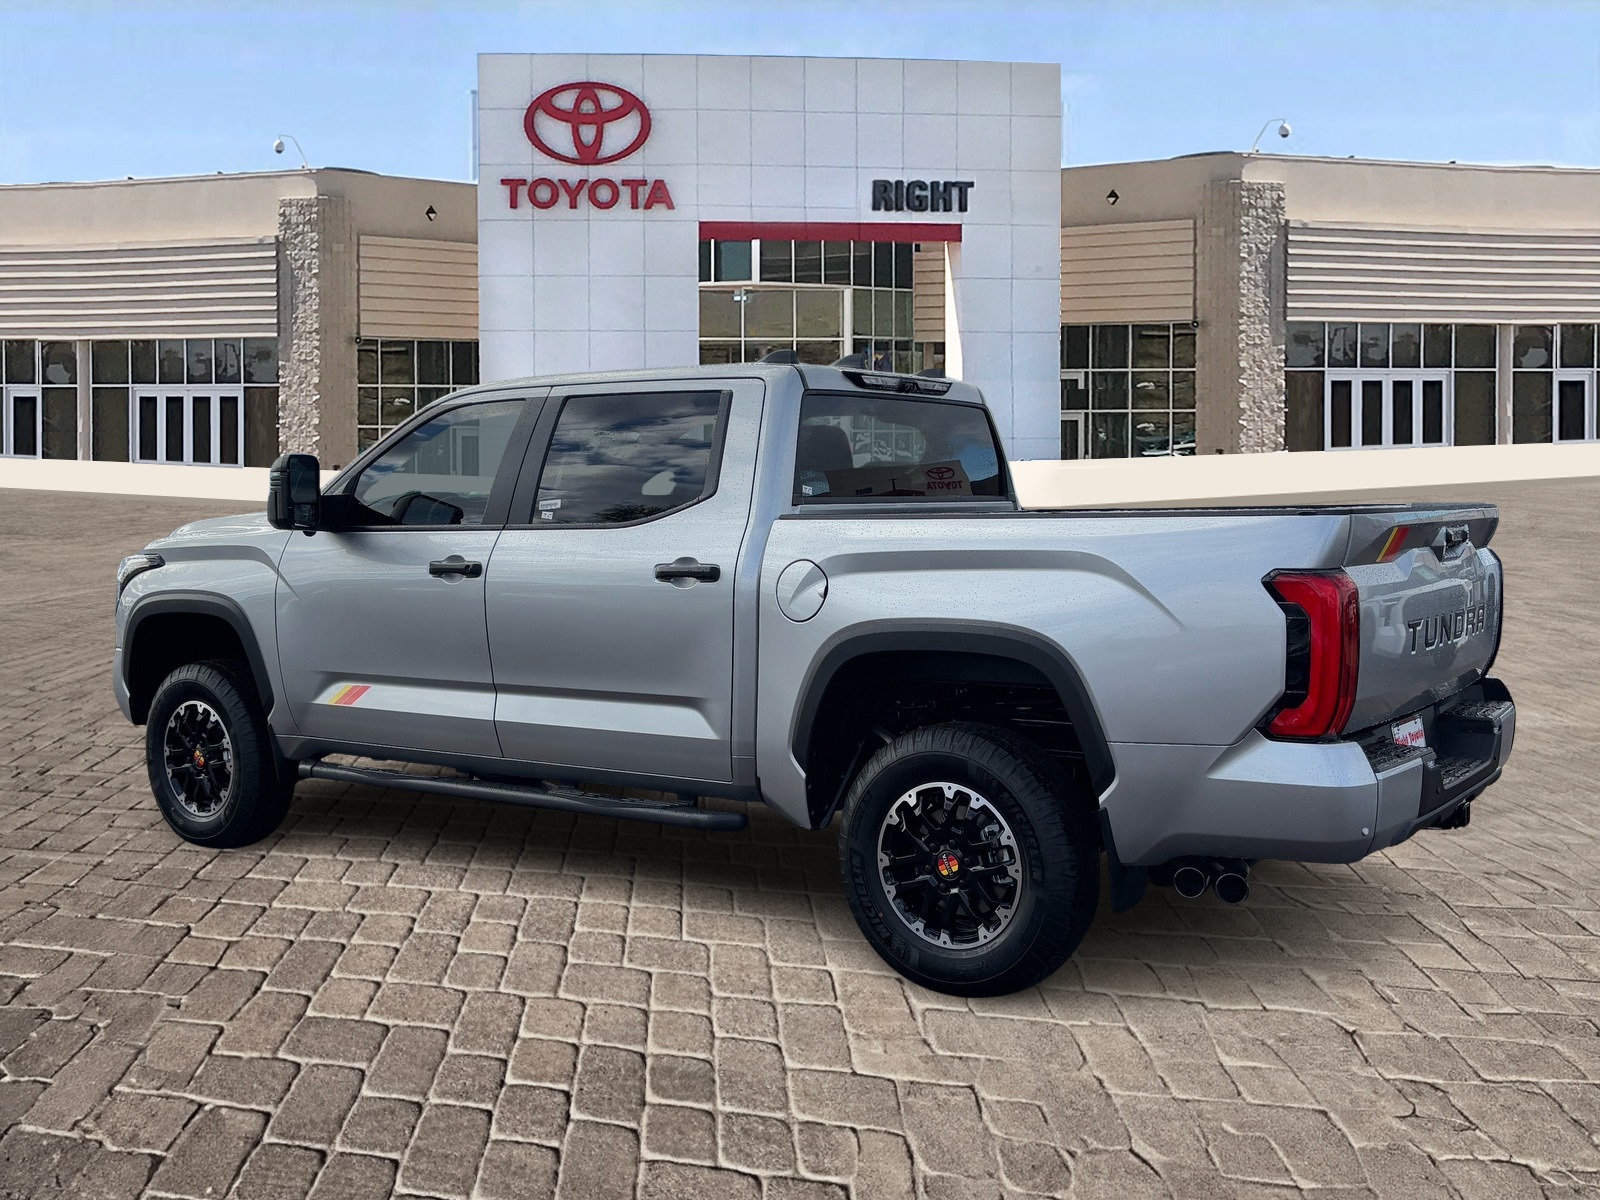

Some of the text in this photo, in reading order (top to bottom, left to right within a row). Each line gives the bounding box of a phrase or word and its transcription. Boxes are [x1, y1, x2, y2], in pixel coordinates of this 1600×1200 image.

[500, 177, 675, 210] TOYOTA
[872, 179, 974, 212] RIGHT
[1407, 603, 1486, 655] TUNDRA
